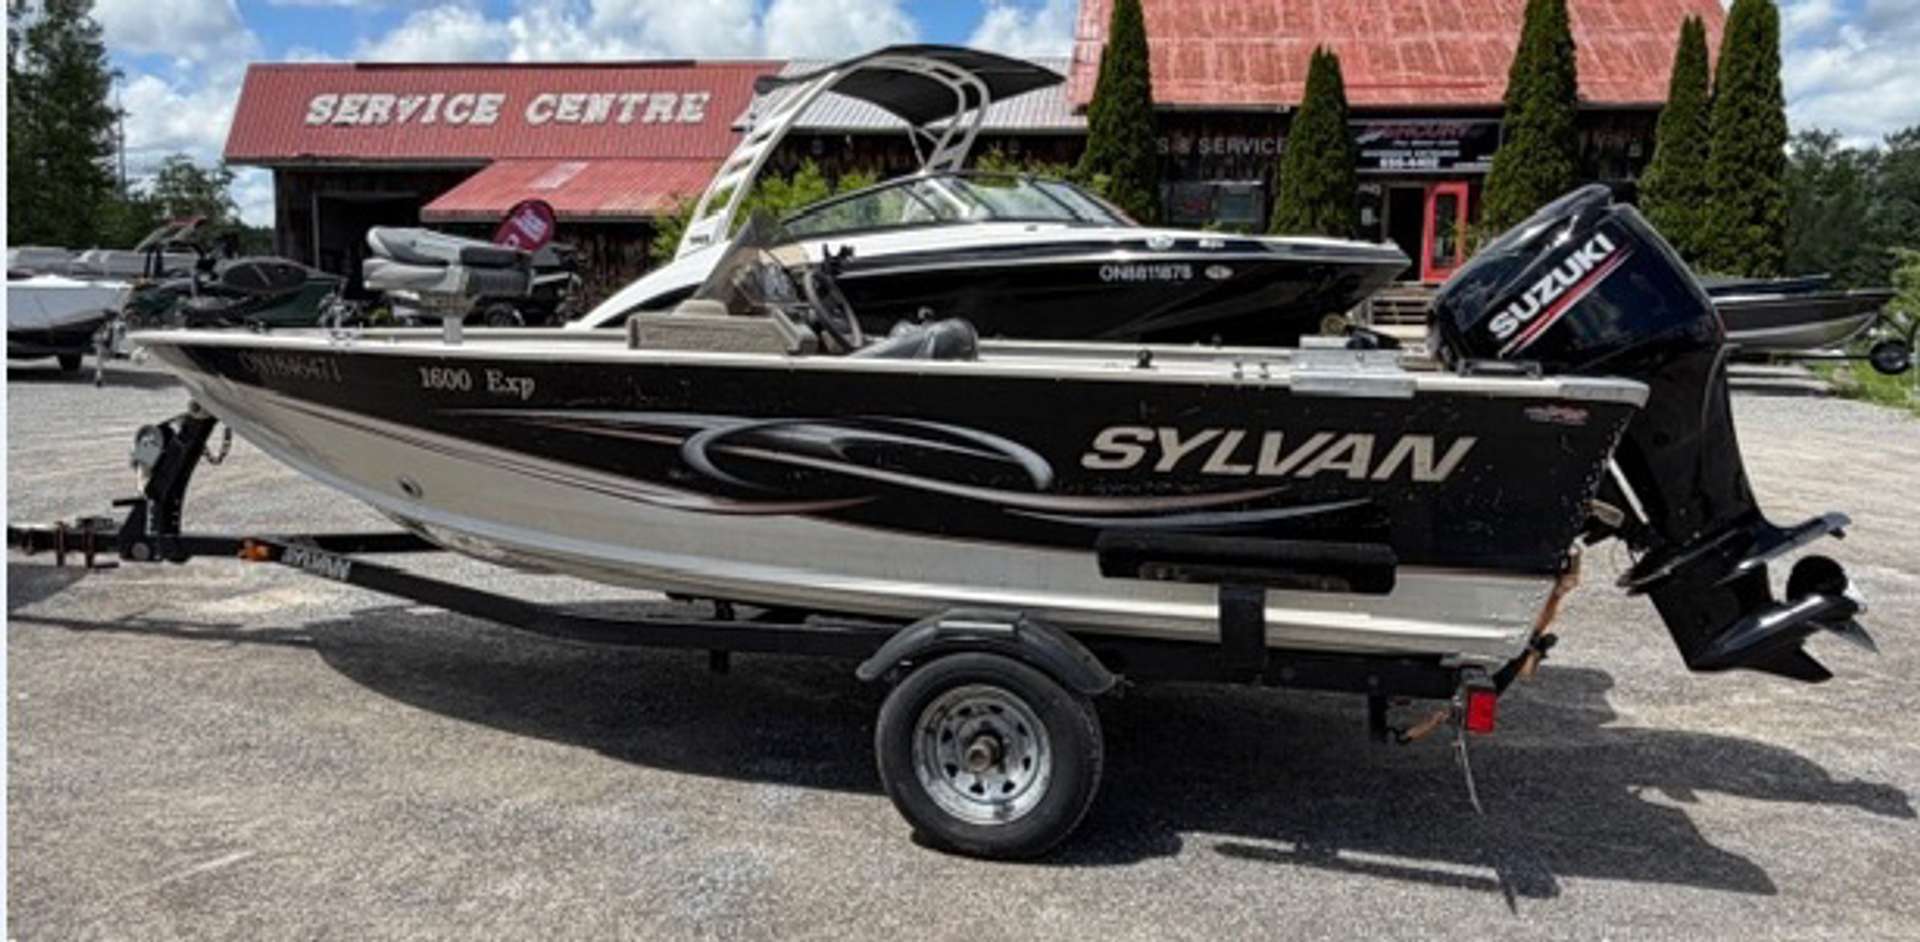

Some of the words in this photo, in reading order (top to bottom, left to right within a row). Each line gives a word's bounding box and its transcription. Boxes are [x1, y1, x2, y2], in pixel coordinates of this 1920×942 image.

[304, 92, 505, 125] SERVICE
[525, 91, 710, 125] CENTRE
[1198, 136, 1287, 155] SERVICE
[1488, 232, 1616, 339] SUZUKI
[419, 367, 472, 391] 1600
[485, 368, 536, 399] Exp
[1080, 425, 1478, 483] SYLVAN
